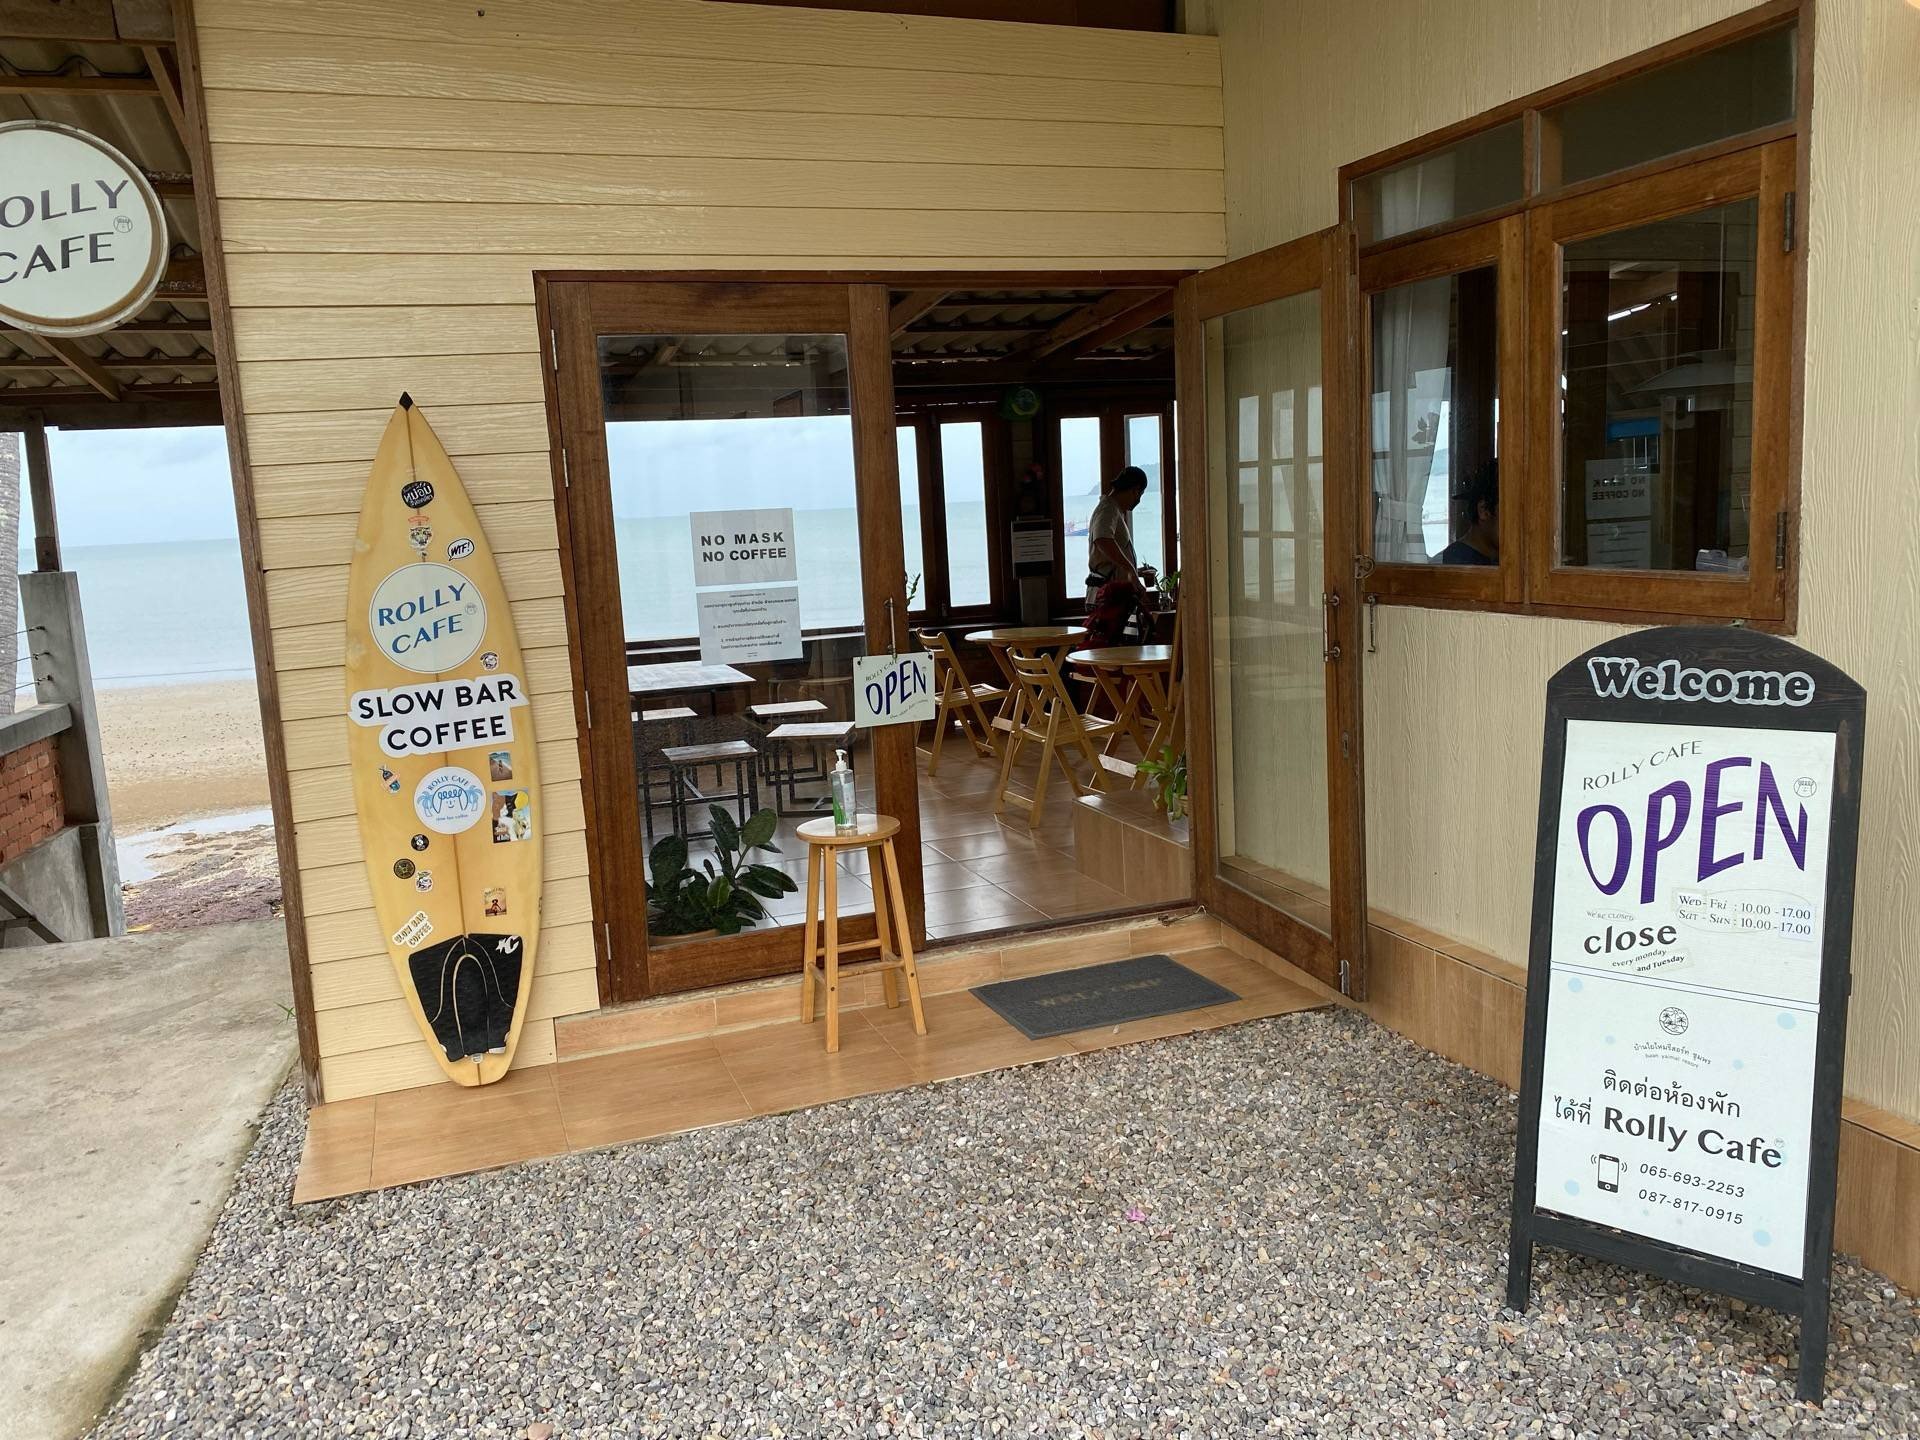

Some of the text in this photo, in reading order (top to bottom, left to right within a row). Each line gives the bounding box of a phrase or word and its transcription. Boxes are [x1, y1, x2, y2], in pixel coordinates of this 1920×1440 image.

[450, 541, 471, 557] WTF!
[701, 532, 784, 546] NO MASK
[702, 547, 787, 562] NO COFFEE
[378, 583, 466, 626] ROLLY
[391, 613, 463, 653] CAFE
[865, 660, 927, 715] OPEN
[1588, 657, 1815, 705] Welcome
[358, 680, 517, 720] SLOW BAR
[387, 715, 506, 750] COFFEE
[427, 775, 449, 791] ROLLY
[1583, 740, 1703, 791] ROLLY CAFE
[1576, 756, 1808, 905] OPEN
[1741, 903, 1771, 915] 10.00
[1782, 907, 1811, 920] 17.00
[1741, 918, 1771, 930] 10.00
[1781, 922, 1811, 935] 17.00
[1584, 925, 1677, 954] close
[1612, 949, 1667, 967] every monday
[1653, 956, 1685, 968] Tuesday
[1603, 1068, 1741, 1118] ติดต่อห้องพัก
[1554, 1095, 1782, 1168] ได้ที่ Rolly Cafe
[1639, 1163, 1745, 1198] 065-693-2253
[1638, 1189, 1743, 1224] 087-817-0915
